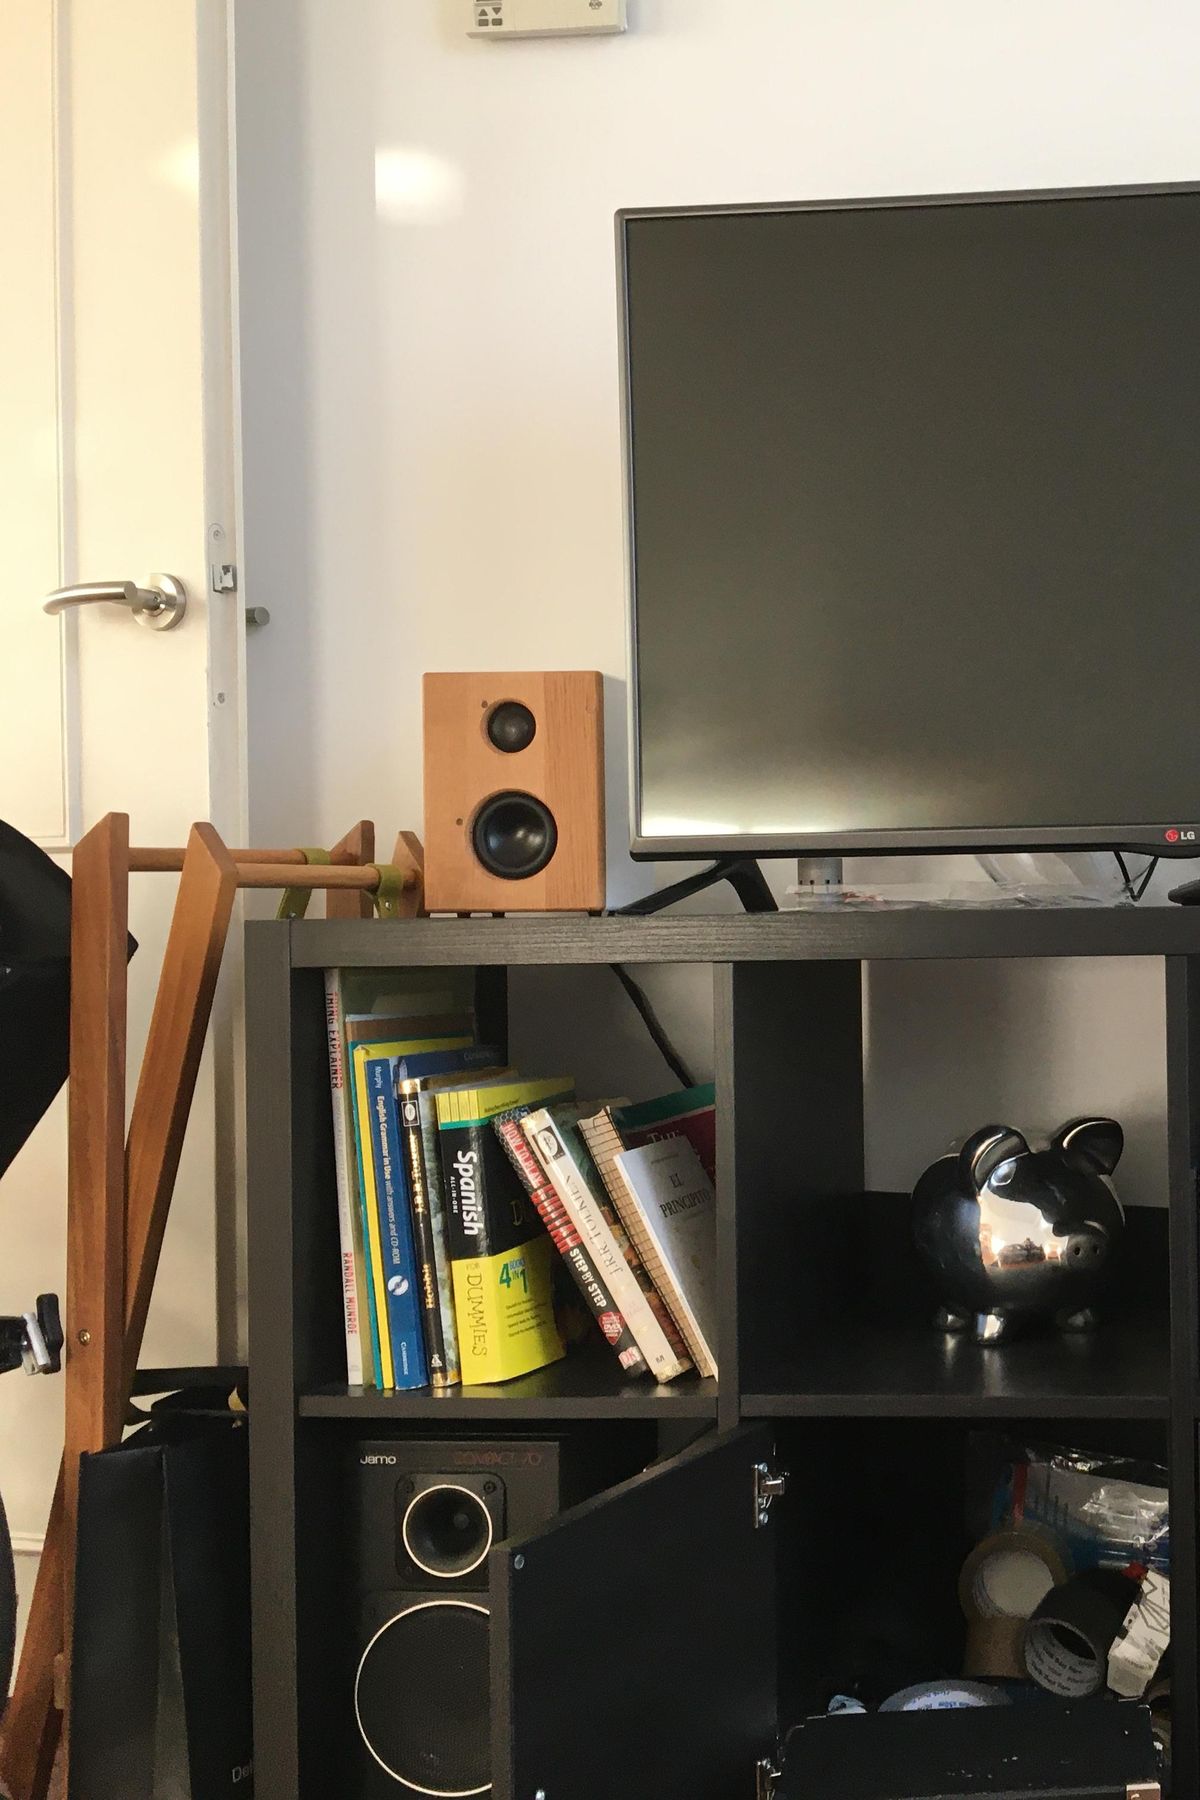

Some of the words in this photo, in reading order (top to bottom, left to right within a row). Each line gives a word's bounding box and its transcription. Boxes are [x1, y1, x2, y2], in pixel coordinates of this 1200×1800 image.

[1180, 831, 1196, 840] LG
[325, 991, 337, 1024] THING
[327, 1030, 342, 1089] EXPLAINER
[372, 1065, 383, 1088] Murphy
[375, 1095, 387, 1122] English
[378, 1122, 390, 1157] Grammar
[503, 1122, 523, 1147] HOW
[382, 1156, 391, 1165] in
[516, 1145, 530, 1160] TO
[383, 1165, 392, 1179] Use
[523, 1160, 543, 1185] PLAY
[669, 1173, 683, 1188] EL
[384, 1179, 394, 1195] with
[450, 1176, 459, 1214] ALL-IN-ONE
[453, 1150, 484, 1235] Spanish
[385, 1195, 396, 1222] answers
[660, 1188, 711, 1218] PRINCIPITO
[388, 1222, 398, 1236] and
[389, 1236, 401, 1264] CD-ROM
[568, 1246, 589, 1274] STEP
[342, 1252, 355, 1293] RANDALL
[499, 1263, 512, 1288] 4
[520, 1268, 528, 1293] 1
[581, 1271, 594, 1284] BY
[587, 1281, 608, 1309] STEP
[345, 1296, 358, 1334] MUNROE
[467, 1275, 487, 1357] DUMMIES
[359, 1454, 397, 1465] Jamo
